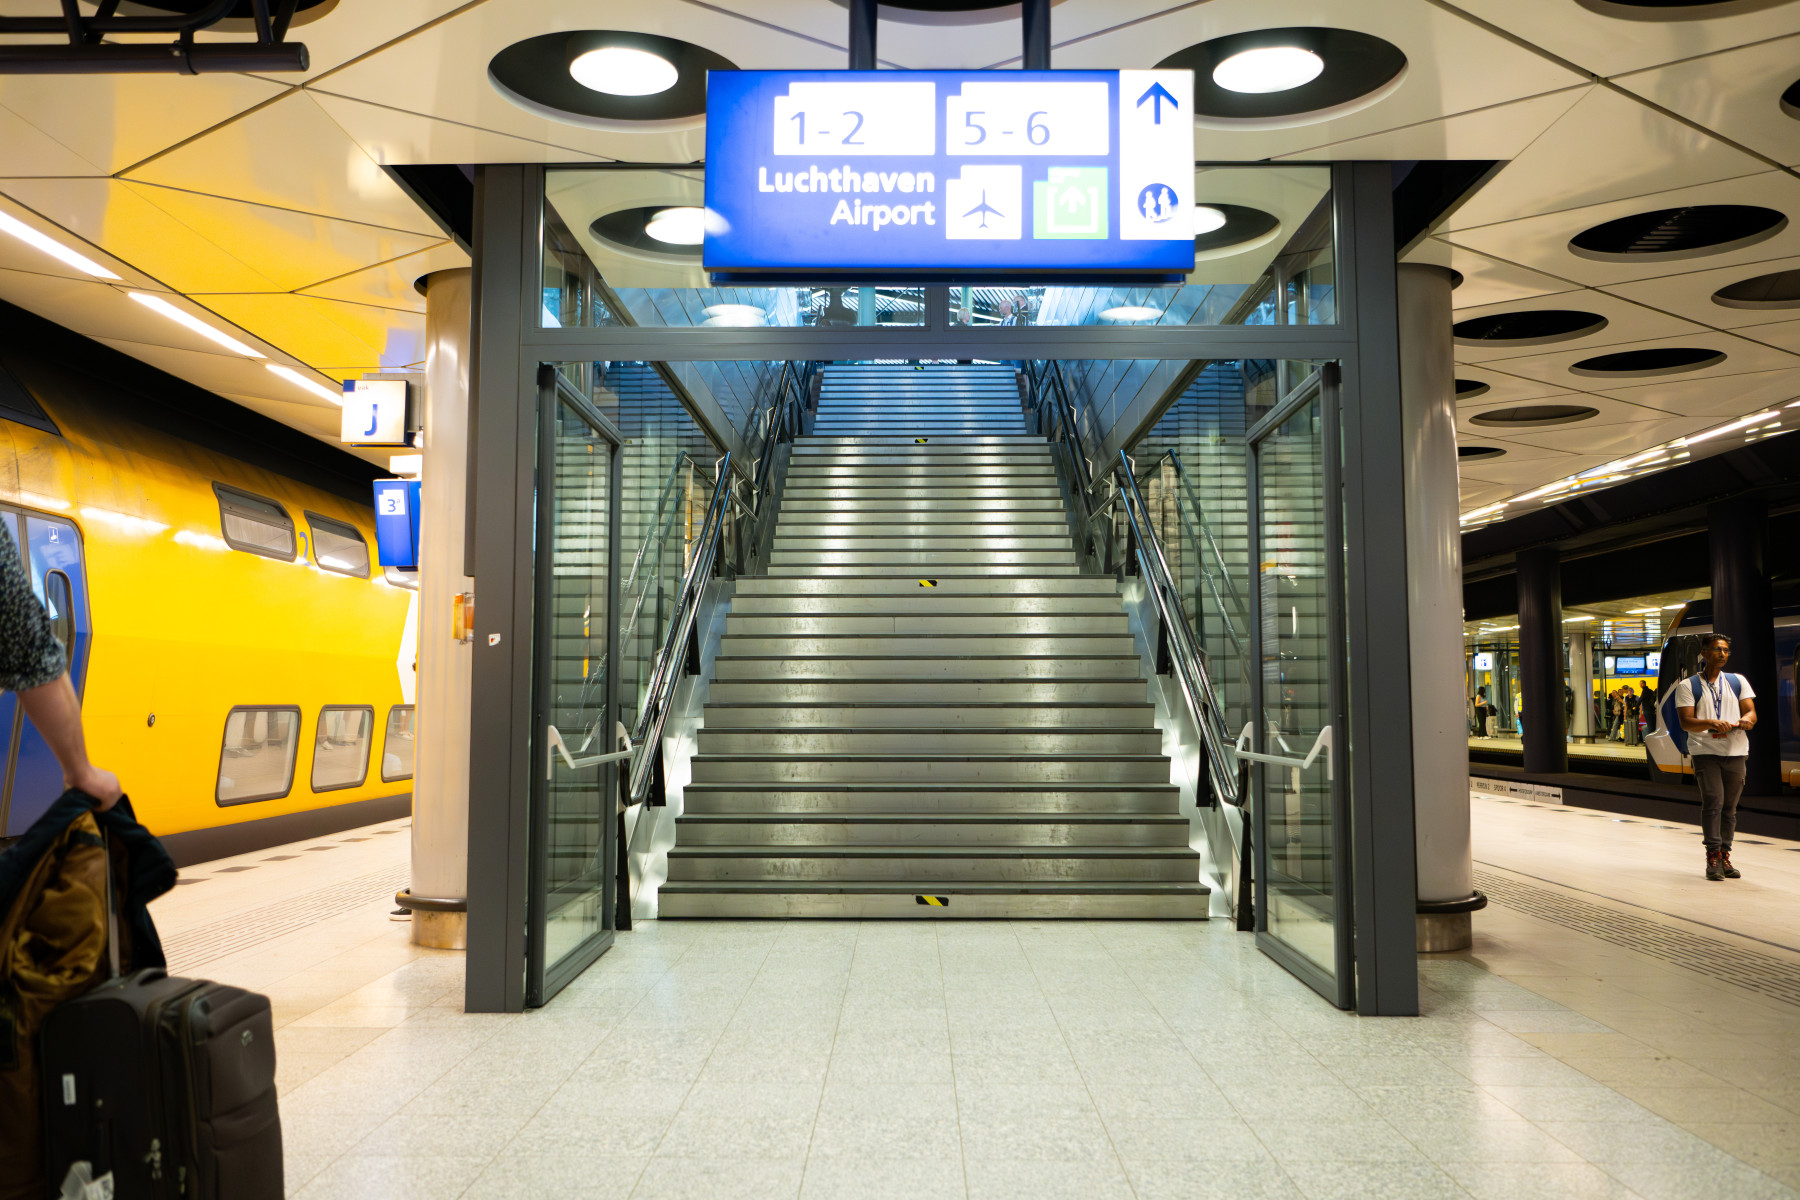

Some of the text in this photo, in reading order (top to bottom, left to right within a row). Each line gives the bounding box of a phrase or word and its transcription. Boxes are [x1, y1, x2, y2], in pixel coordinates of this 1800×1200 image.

[758, 165, 935, 193] Luchthaven
[829, 199, 936, 231] Airport
[364, 403, 378, 436] J
